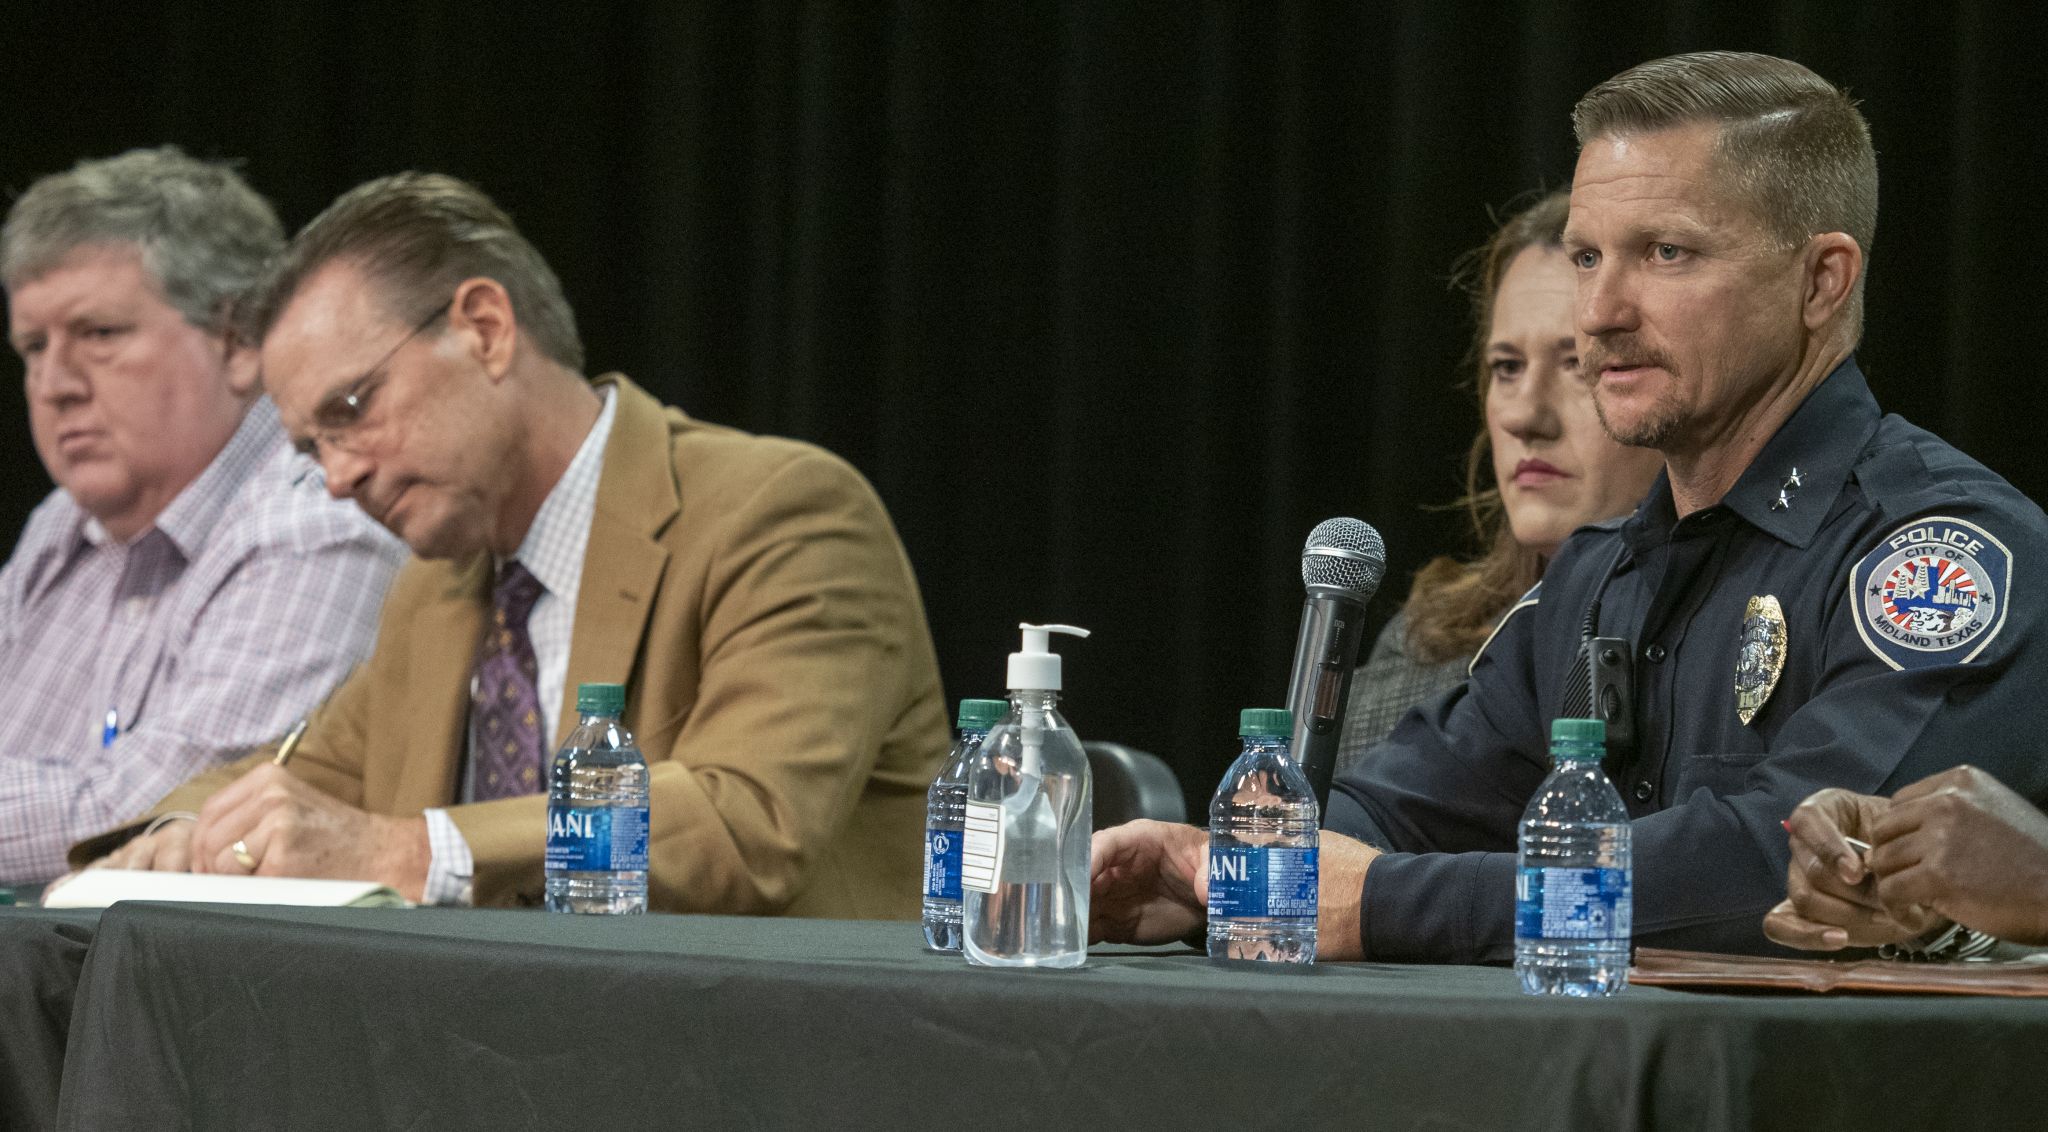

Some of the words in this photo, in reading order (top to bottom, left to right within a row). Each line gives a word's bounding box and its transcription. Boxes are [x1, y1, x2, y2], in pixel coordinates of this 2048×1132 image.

[1889, 527, 1985, 556] POLICE
[1905, 546, 1938, 558] CITY
[1944, 550, 1964, 562] OF
[1874, 615, 1931, 647] MIDLAND
[1936, 619, 1983, 647] TEXAS
